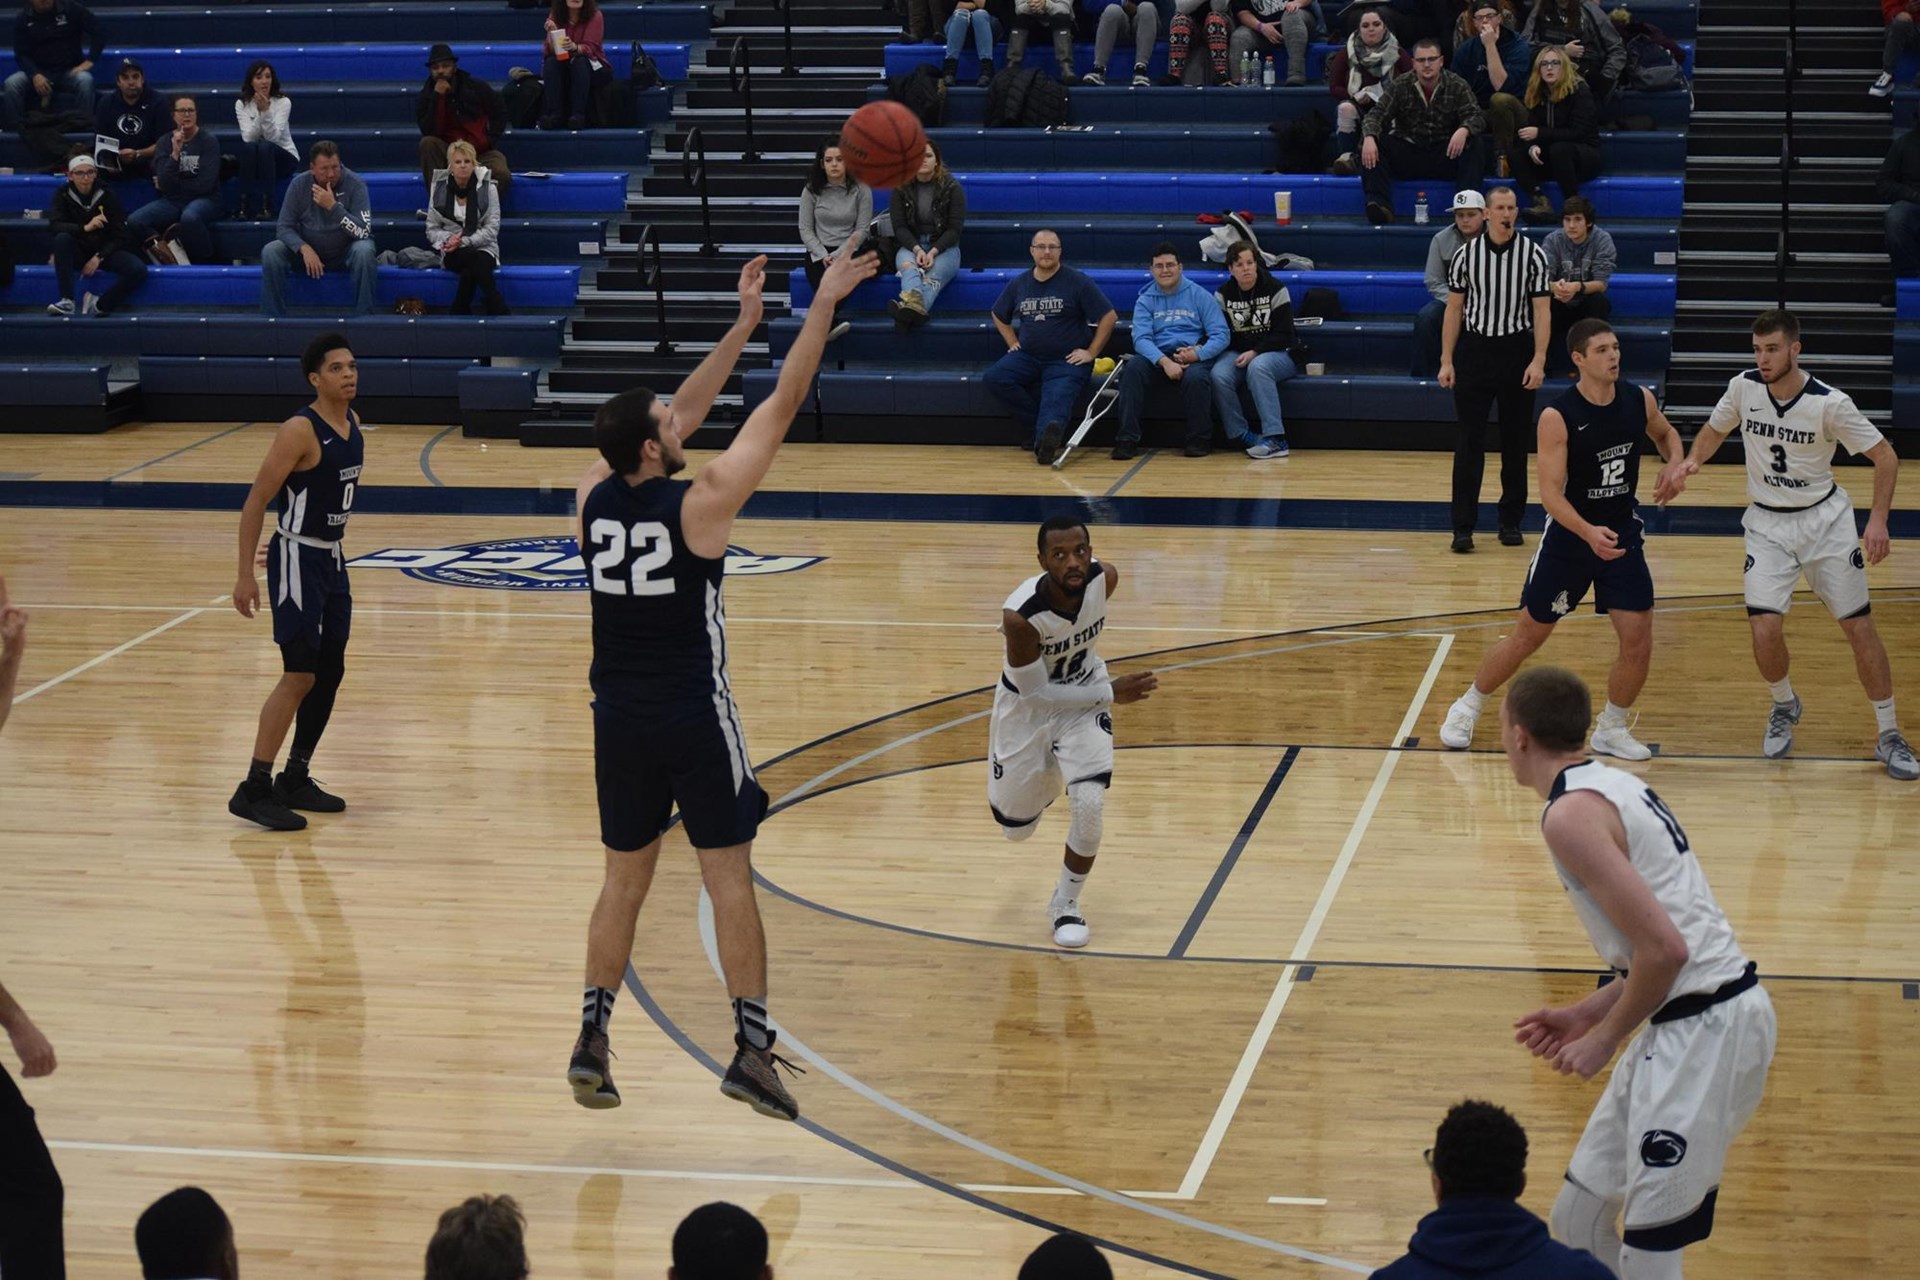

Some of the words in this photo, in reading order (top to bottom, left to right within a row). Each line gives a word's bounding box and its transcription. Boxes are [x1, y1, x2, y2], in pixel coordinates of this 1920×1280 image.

[340, 215, 363, 239] PENN
[1020, 300, 1038, 312] PENN
[1040, 298, 1064, 310] STATE
[1227, 295, 1270, 310] PENINS
[1745, 419, 1776, 438] PENN
[1778, 426, 1816, 445] STATE
[1599, 444, 1631, 461] MOUNT
[1769, 443, 1788, 473] 3
[1600, 459, 1625, 487] 12
[342, 482, 354, 510] 0
[590, 518, 676, 596] 22
[1037, 637, 1071, 657] PENN
